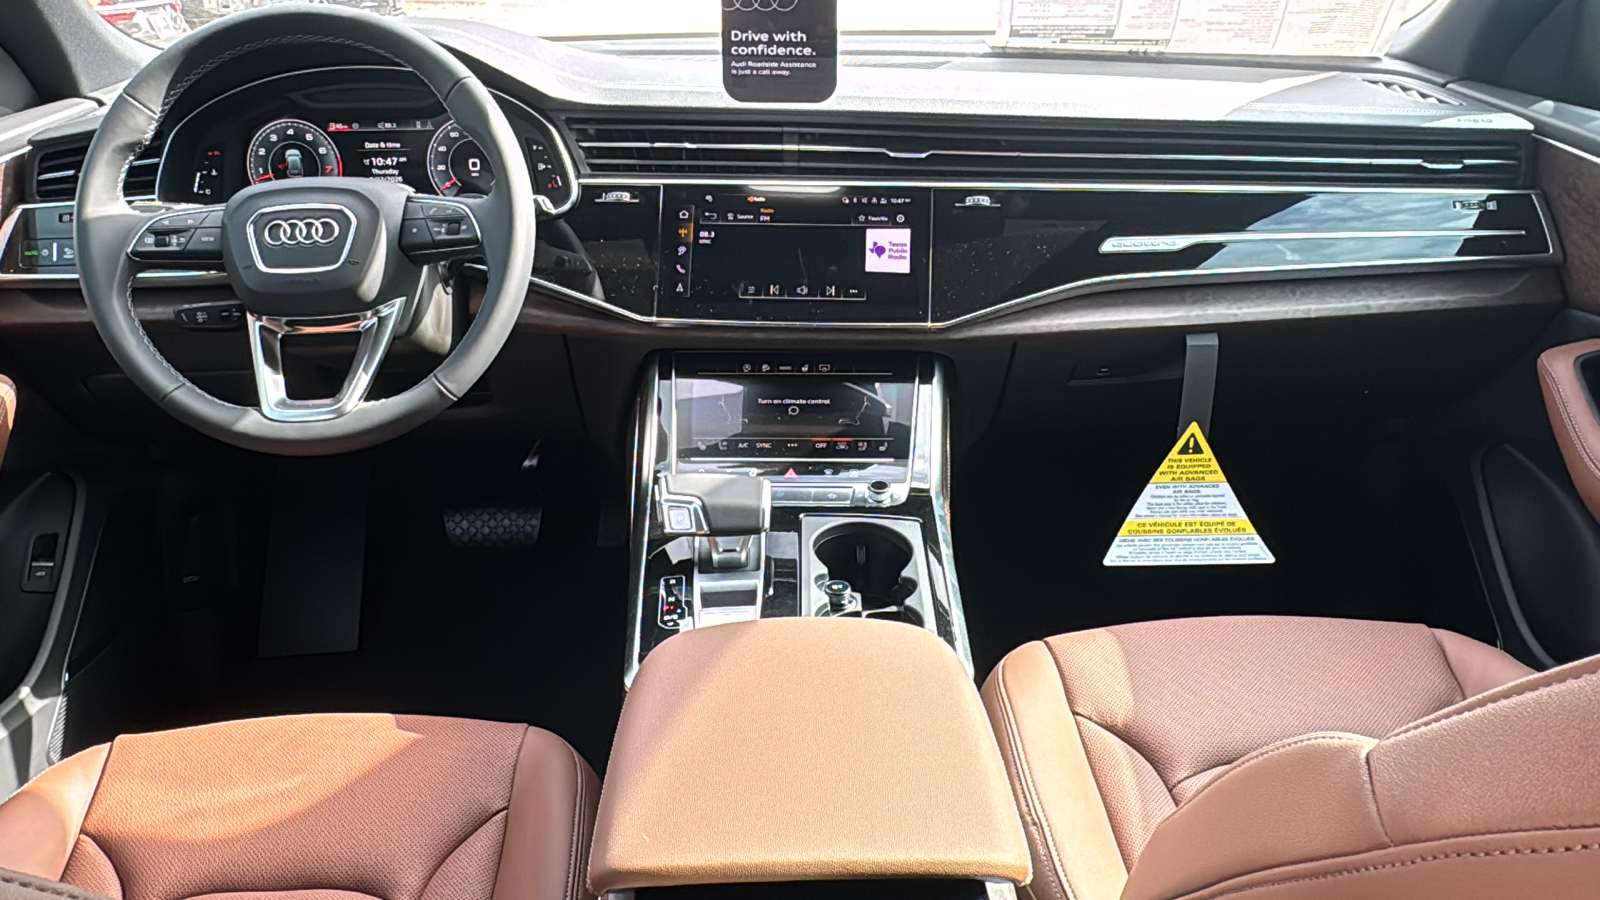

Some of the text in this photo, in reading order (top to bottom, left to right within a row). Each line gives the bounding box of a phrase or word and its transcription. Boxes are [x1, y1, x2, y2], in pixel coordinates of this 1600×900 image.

[731, 30, 807, 42] Drive with
[731, 44, 817, 56] confidence.
[739, 69, 751, 77] just
[772, 69, 791, 77] away.
[286, 128, 294, 136] 4
[269, 134, 279, 142] 3
[305, 133, 314, 141] 5
[364, 141, 379, 149] Date
[380, 141, 385, 149] &
[258, 148, 267, 156] 2
[318, 147, 328, 155] 6
[371, 157, 398, 167] 10:47
[468, 158, 481, 171] 0
[325, 165, 334, 173] 7
[371, 168, 400, 176] Thursday
